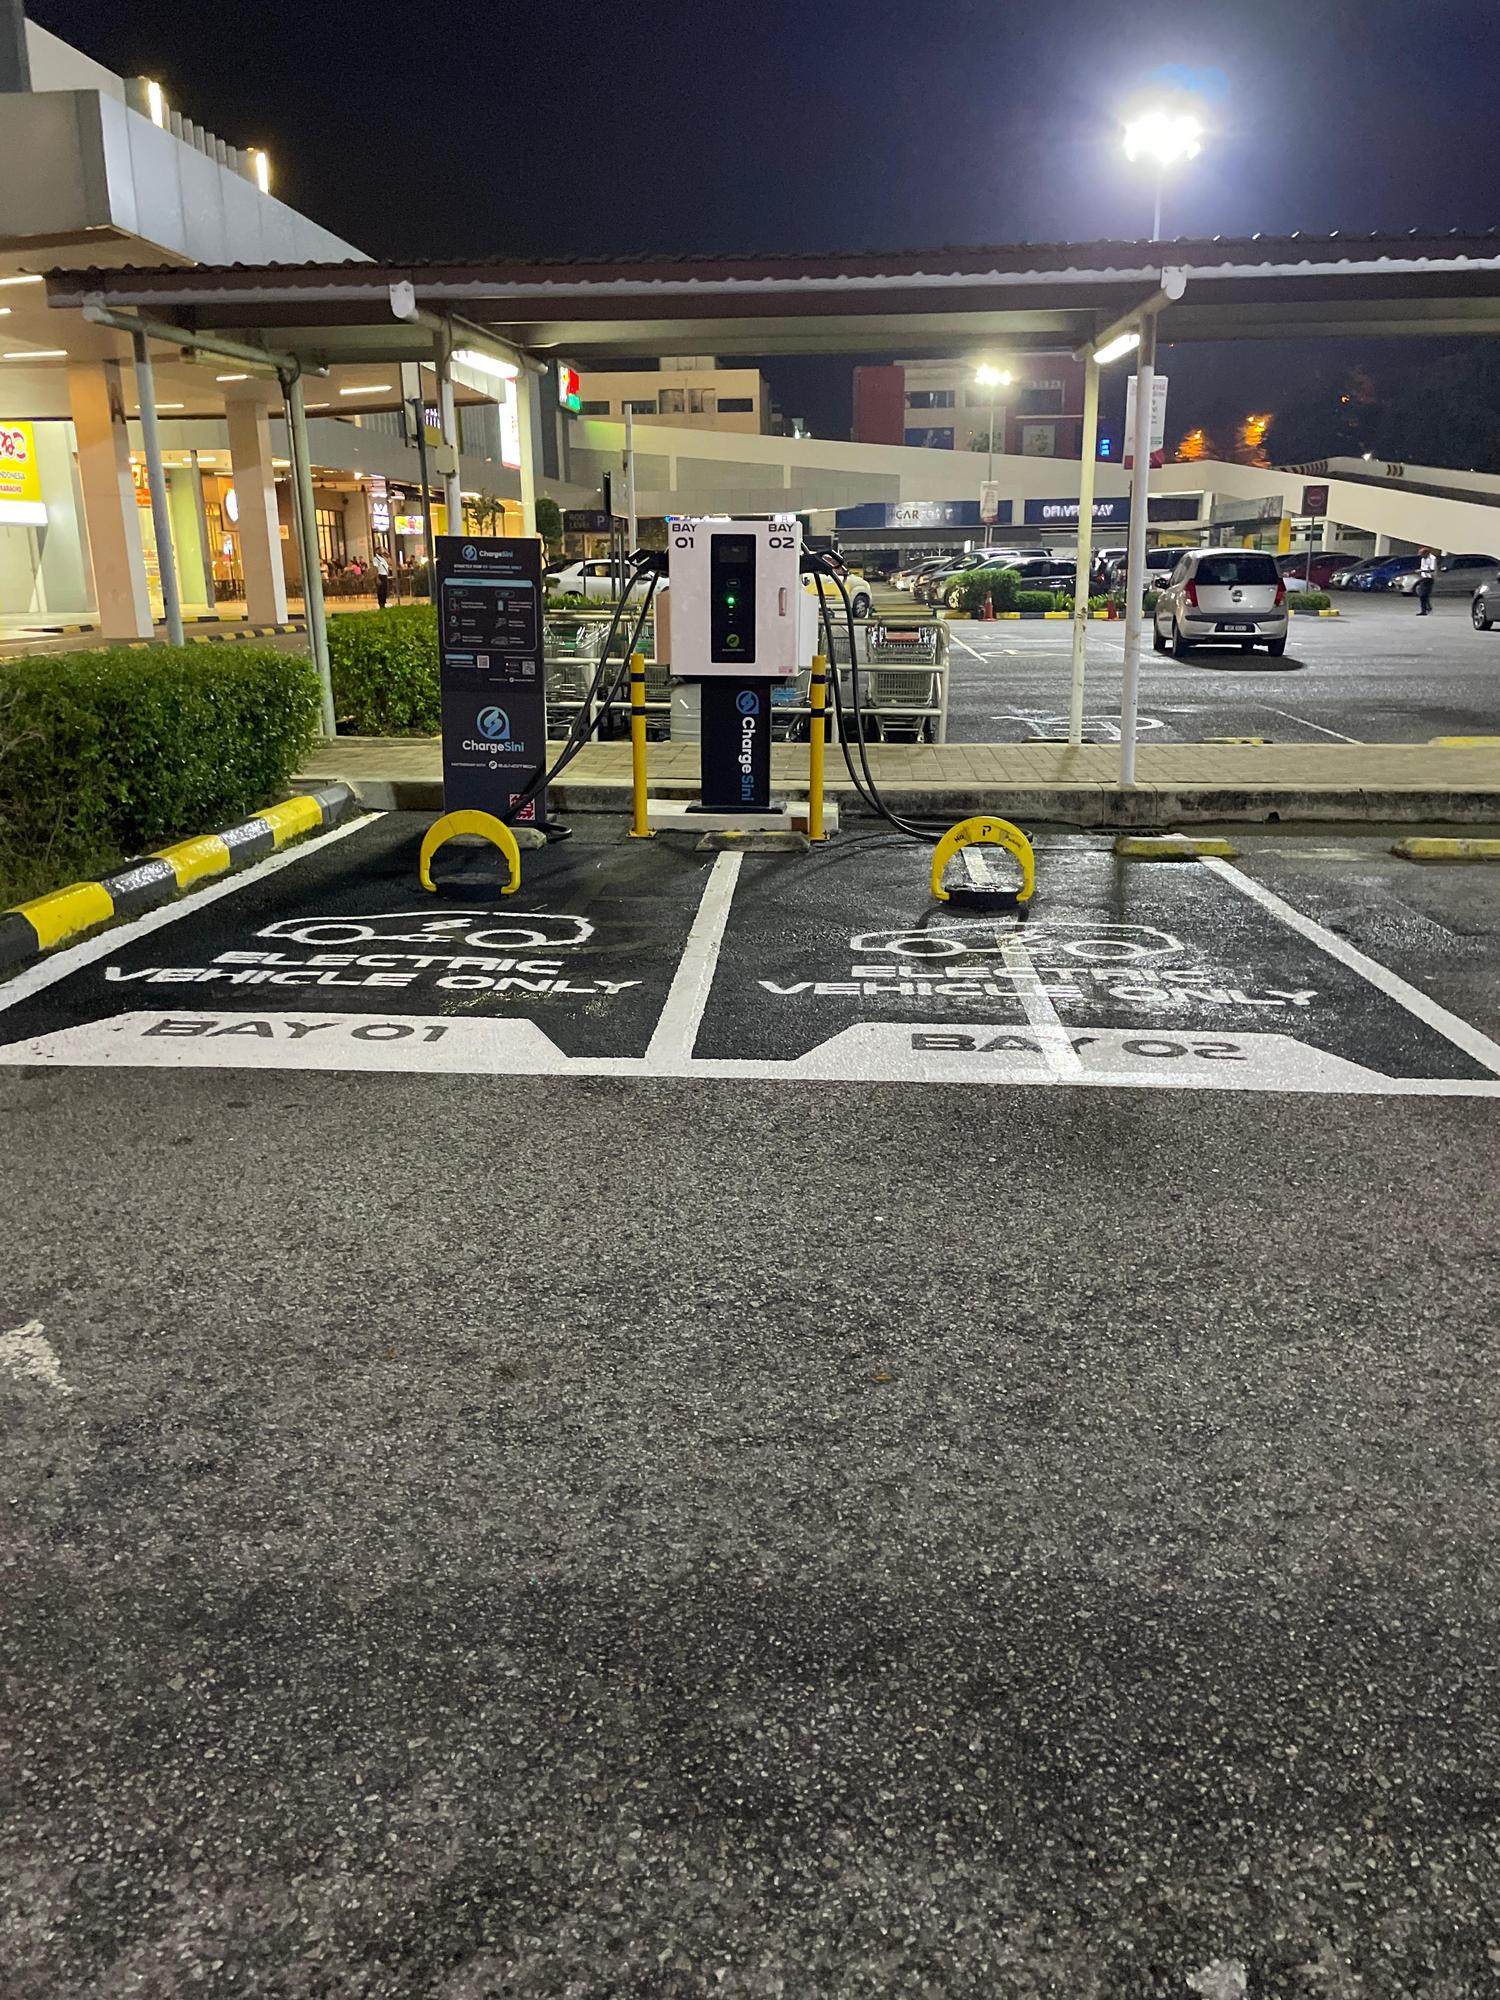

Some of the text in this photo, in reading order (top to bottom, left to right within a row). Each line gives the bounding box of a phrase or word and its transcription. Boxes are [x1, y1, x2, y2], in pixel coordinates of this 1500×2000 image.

[672, 524, 698, 532] BAY
[768, 524, 794, 532] BAY
[675, 537, 694, 548] 01
[769, 537, 795, 548] 02
[462, 740, 525, 753] ChargeSini
[738, 717, 756, 801] ChargeSini
[211, 951, 565, 975] ELECTRIC
[105, 966, 643, 994] VEHICLE ONLY
[851, 965, 1211, 983] ELECTRIC
[757, 980, 1319, 1006] VEHICLE ONLY
[141, 1019, 450, 1042] BAY 01
[1121, 1040, 1248, 1061] 02
